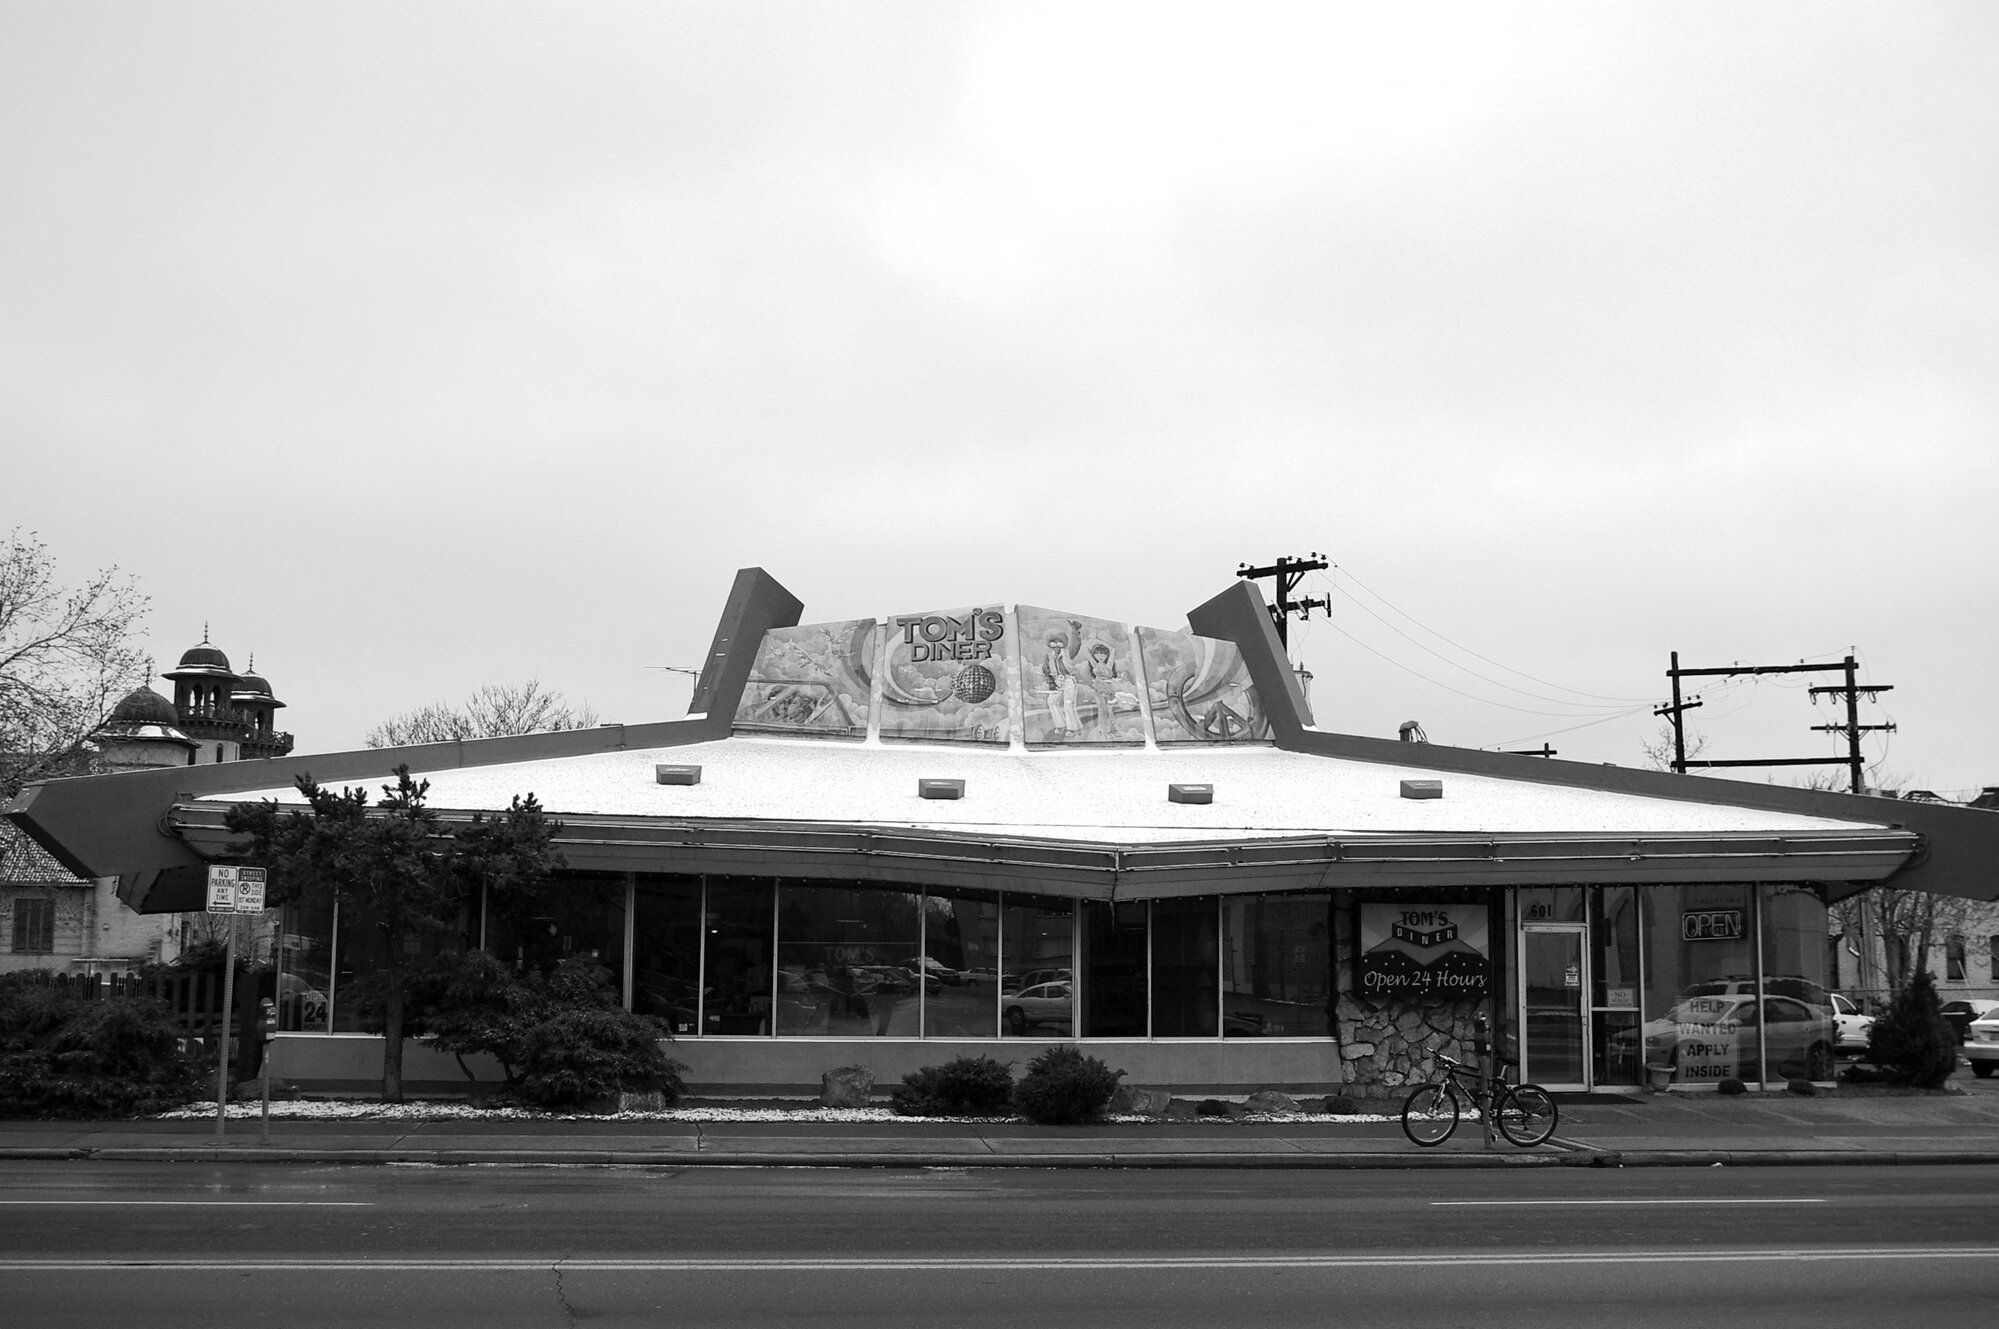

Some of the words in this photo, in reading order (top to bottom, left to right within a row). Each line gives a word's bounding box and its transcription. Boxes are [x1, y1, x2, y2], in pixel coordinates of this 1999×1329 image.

[896, 607, 1004, 644] TOM'S
[910, 640, 993, 662] DINER
[218, 869, 230, 878] NO
[211, 878, 235, 887] PARKING
[1400, 909, 1449, 926] TOM'S
[1531, 904, 1551, 918] 601
[1685, 913, 1739, 937] OPEN
[1396, 927, 1454, 945] DINER
[1364, 970, 1410, 992] Open
[1412, 970, 1432, 986] 24
[1436, 969, 1488, 987] Hours
[304, 1001, 328, 1023] 24
[1690, 1000, 1725, 1013] HELP
[303, 1023, 329, 1031] HOURS
[1678, 1022, 1737, 1035] WANTED
[1686, 1044, 1730, 1057] APPLY
[1685, 1064, 1731, 1078] INSIDE
